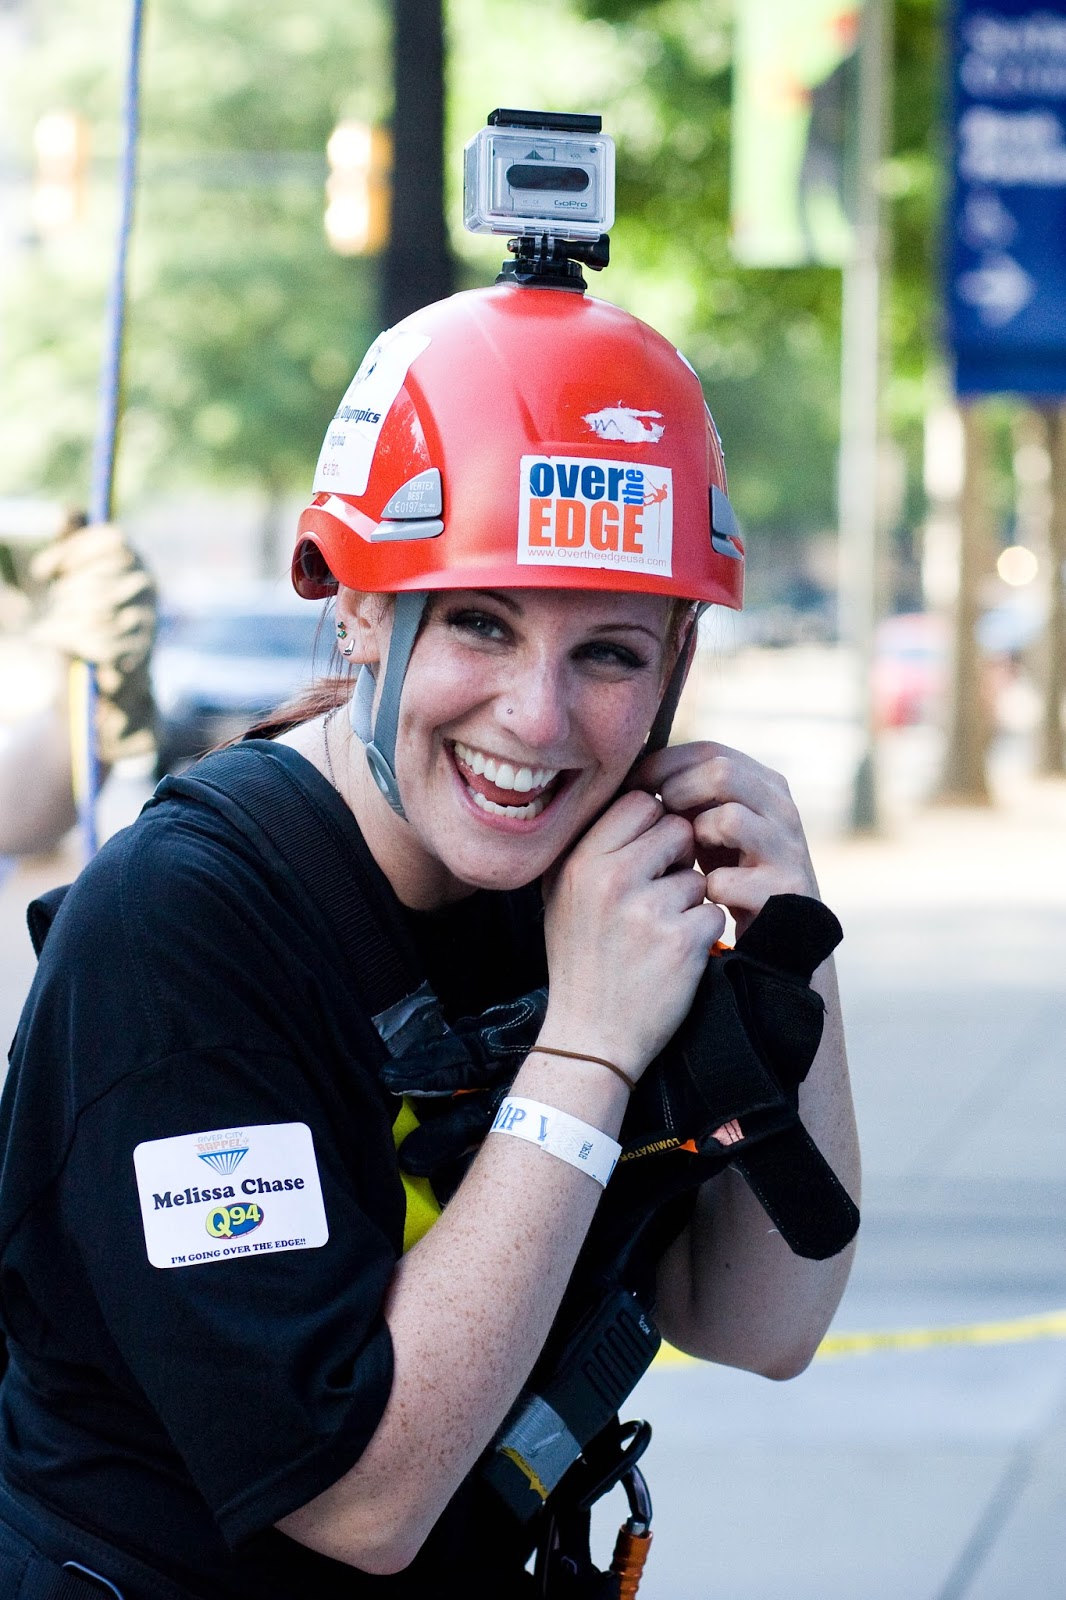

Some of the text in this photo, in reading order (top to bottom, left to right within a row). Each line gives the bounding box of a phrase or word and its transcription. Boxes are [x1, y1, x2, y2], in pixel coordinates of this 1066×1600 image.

[340, 405, 382, 424] Olympics
[409, 481, 435, 491] VERTEX
[529, 462, 644, 505] over the
[407, 491, 424, 501] BEST
[528, 498, 644, 554] EDGE
[527, 547, 667, 568] www.Overtheedgeusa.com
[194, 1138, 242, 1152] RAPPEL
[197, 1131, 244, 1143] RIVER CITY
[152, 1177, 305, 1210] Melissa Chase
[206, 1203, 261, 1238] Q94
[171, 1238, 306, 1264] I'M GOING OVER THE EDGE!!
